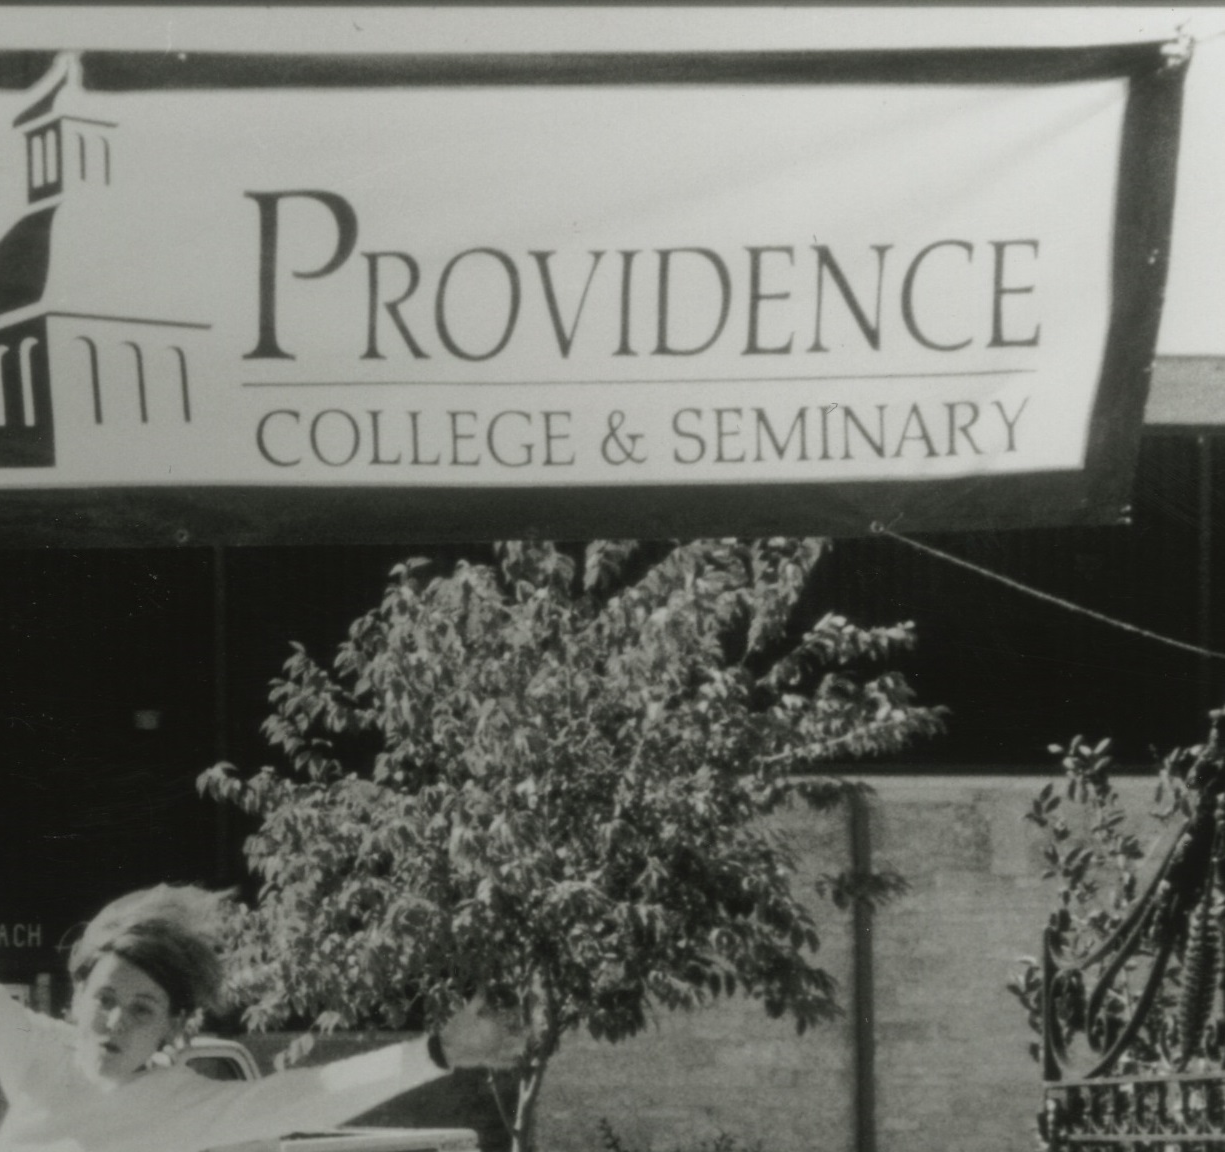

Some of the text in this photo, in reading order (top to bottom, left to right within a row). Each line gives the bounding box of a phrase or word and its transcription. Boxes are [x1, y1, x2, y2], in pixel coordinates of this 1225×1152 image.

[241, 189, 1042, 362] PROVIDENCE
[255, 397, 1031, 468] COLLEGE & SEMINARY
